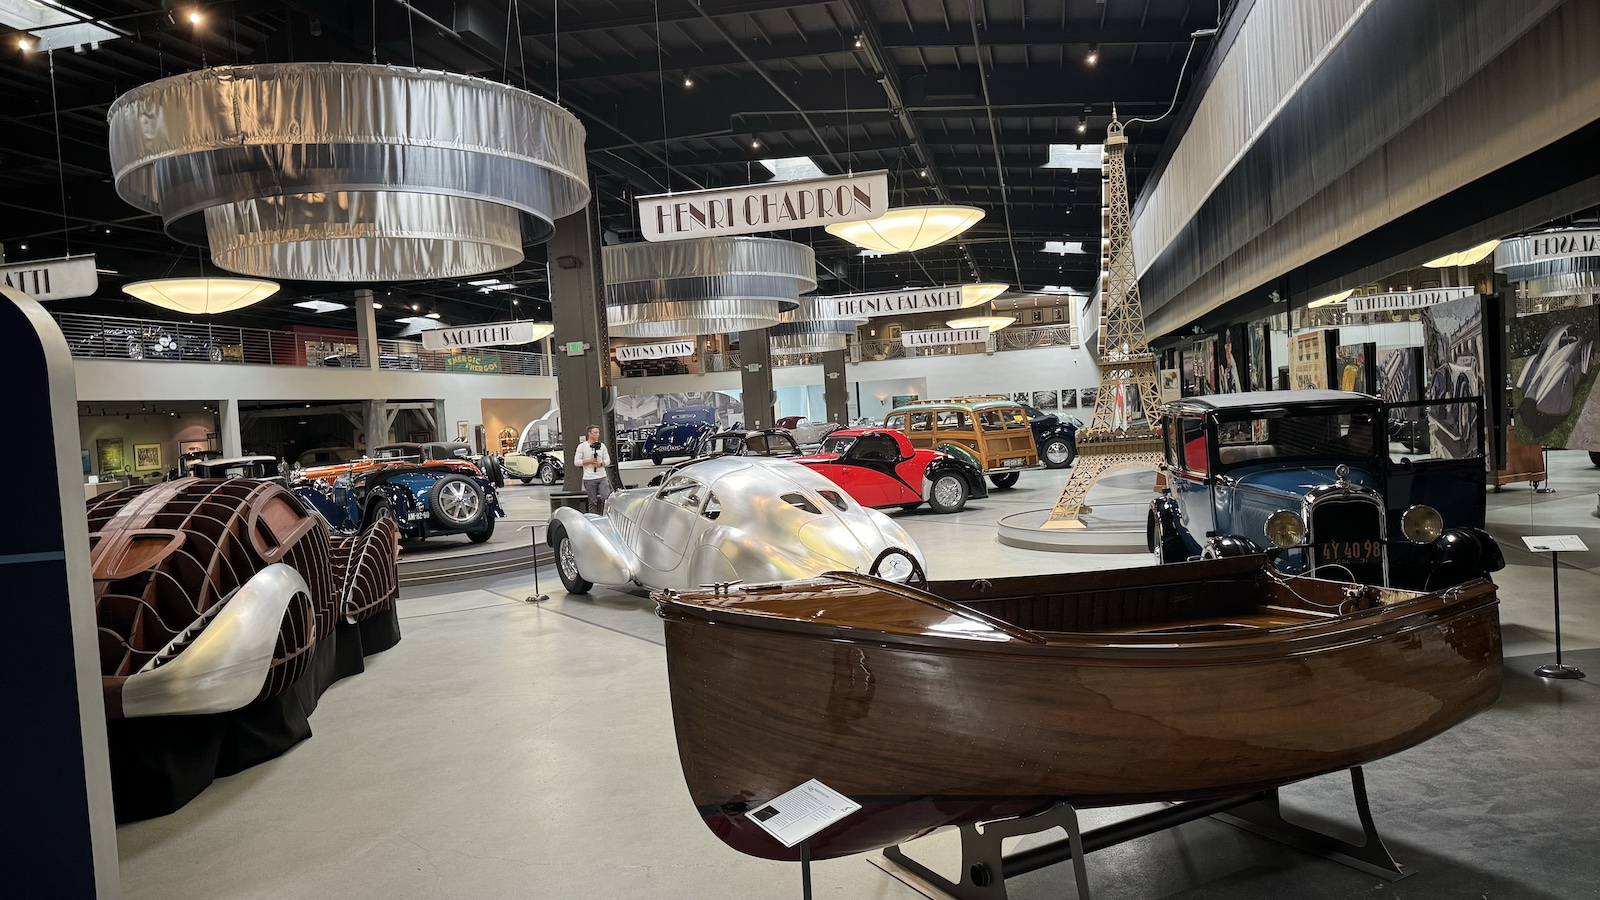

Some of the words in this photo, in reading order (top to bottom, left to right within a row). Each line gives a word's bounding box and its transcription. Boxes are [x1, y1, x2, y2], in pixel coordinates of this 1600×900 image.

[654, 198, 734, 234] HENRI
[743, 182, 872, 227] CHAPRON
[838, 298, 881, 316] FIGONI
[883, 297, 894, 311] &
[898, 290, 961, 310] FALASCHI
[442, 326, 514, 347] SAOUTCHIK
[910, 329, 982, 345] LABOURDETTE
[620, 346, 655, 359] AVIONS
[658, 343, 691, 356] VOISIN
[1322, 542, 1340, 560] 4Y
[1344, 541, 1361, 559] 40
[1363, 540, 1381, 559] 98
